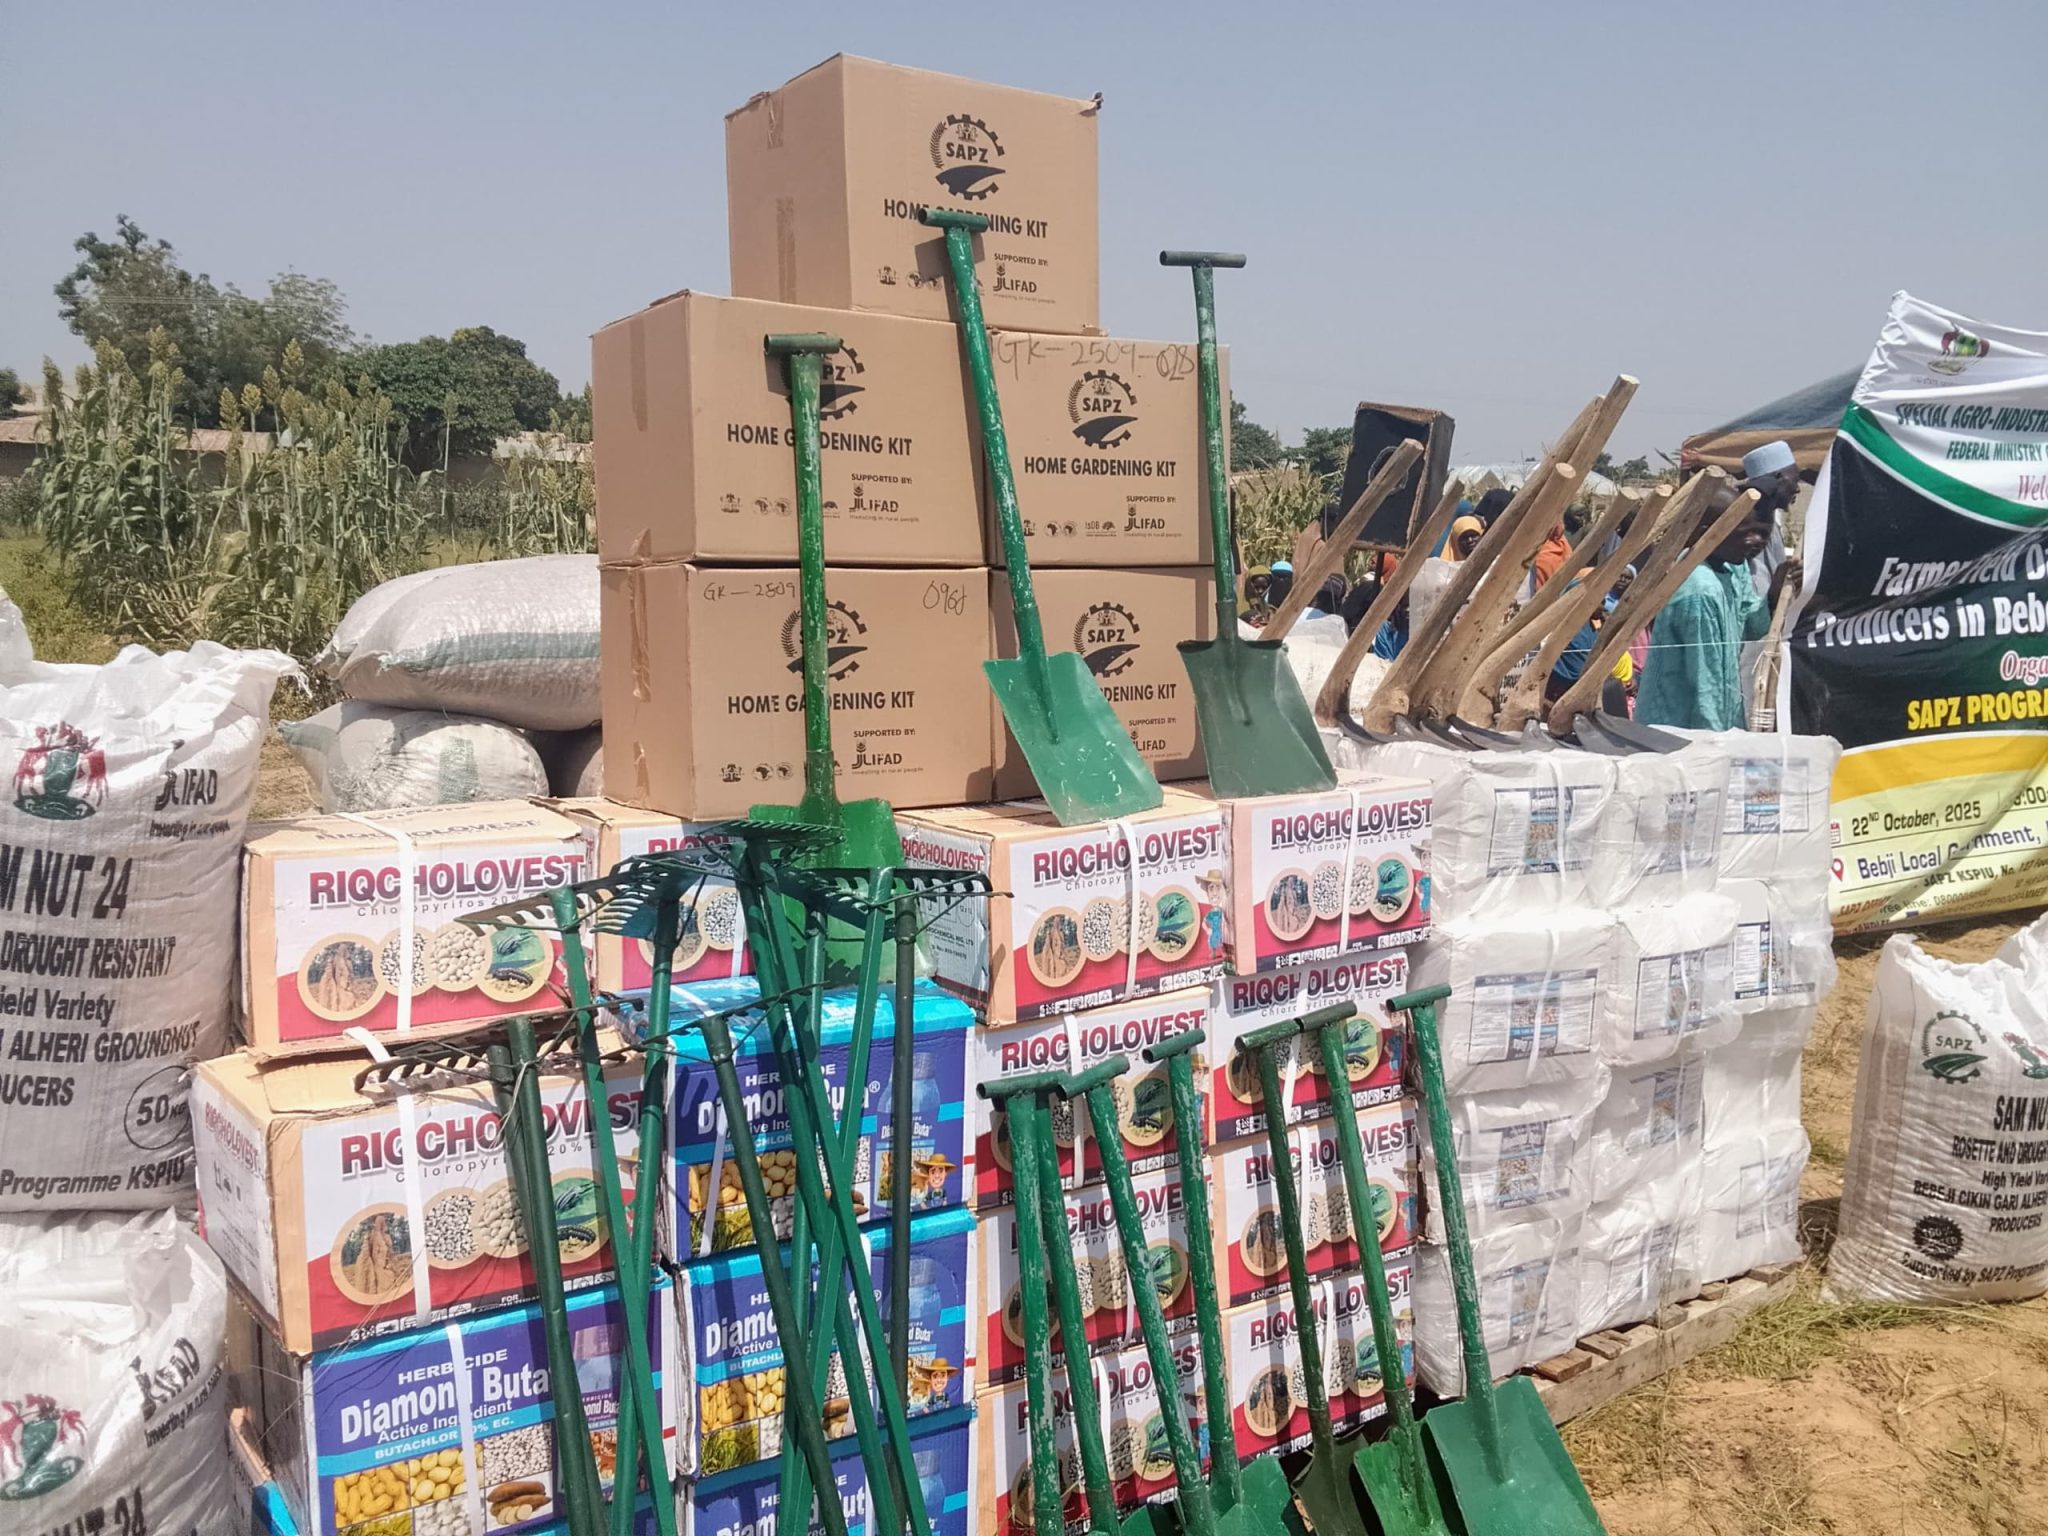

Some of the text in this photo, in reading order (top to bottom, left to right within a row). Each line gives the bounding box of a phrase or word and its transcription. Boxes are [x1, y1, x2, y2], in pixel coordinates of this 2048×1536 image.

[945, 142, 989, 163] SAPZ
[884, 198, 929, 221] HOM
[1026, 219, 1048, 239] KIT
[994, 252, 1036, 266] SUPPORTED
[1010, 279, 1037, 294] IFAD
[1082, 397, 1122, 413] SAPZ
[1895, 402, 1951, 428] SPECIAL
[727, 424, 912, 455] HOME GDENING KIT
[1946, 441, 1991, 461] FEDERAL
[1993, 443, 2043, 461] MINISTRY
[1024, 456, 1176, 477] HOME GARDENING KIT
[851, 473, 912, 485] SUPPORTED BY:
[869, 499, 899, 513] IFAD
[1126, 495, 1165, 503] SUPPORTED
[1140, 518, 1165, 530] IFAD
[1807, 592, 2048, 649] Producers in Beb
[1087, 629, 1125, 643] SAPZ
[1158, 683, 1176, 699] KIT
[728, 695, 780, 714] HOME
[891, 690, 915, 708] KIT
[1128, 718, 1165, 726] SUPPORTED
[1907, 696, 1961, 732] SAPZ
[853, 728, 902, 738] SUPPORTED
[1142, 740, 1166, 751] IFAD
[872, 753, 902, 766] IFAD
[1884, 811, 1940, 832] October,
[1945, 800, 1982, 823] 2025
[1857, 845, 1941, 880] Bebji Local
[24, 848, 96, 918] NUT
[92, 857, 133, 919] 24
[0, 930, 177, 980] DROUGHT RESISTANT
[44, 988, 117, 1028] Variety
[8, 1020, 201, 1064] ALHERI GROUNDNUT
[1935, 1033, 1974, 1051] SAPZ
[1993, 1095, 2028, 1132] SAM
[549, 1141, 582, 1156] 20%
[1952, 1135, 1996, 1163] ROSETTE
[0, 1157, 185, 1200] Programme KSPIU
[1982, 1170, 2006, 1191] High
[2011, 1171, 2033, 1188] Yield
[1993, 1195, 2018, 1211] GARI
[1988, 1213, 2043, 1232] PRODUCERS
[732, 1338, 774, 1359] Active
[398, 1349, 508, 1386] HERBCIDE
[377, 1421, 428, 1445] Active
[374, 1430, 459, 1460] BUTACHLOR
